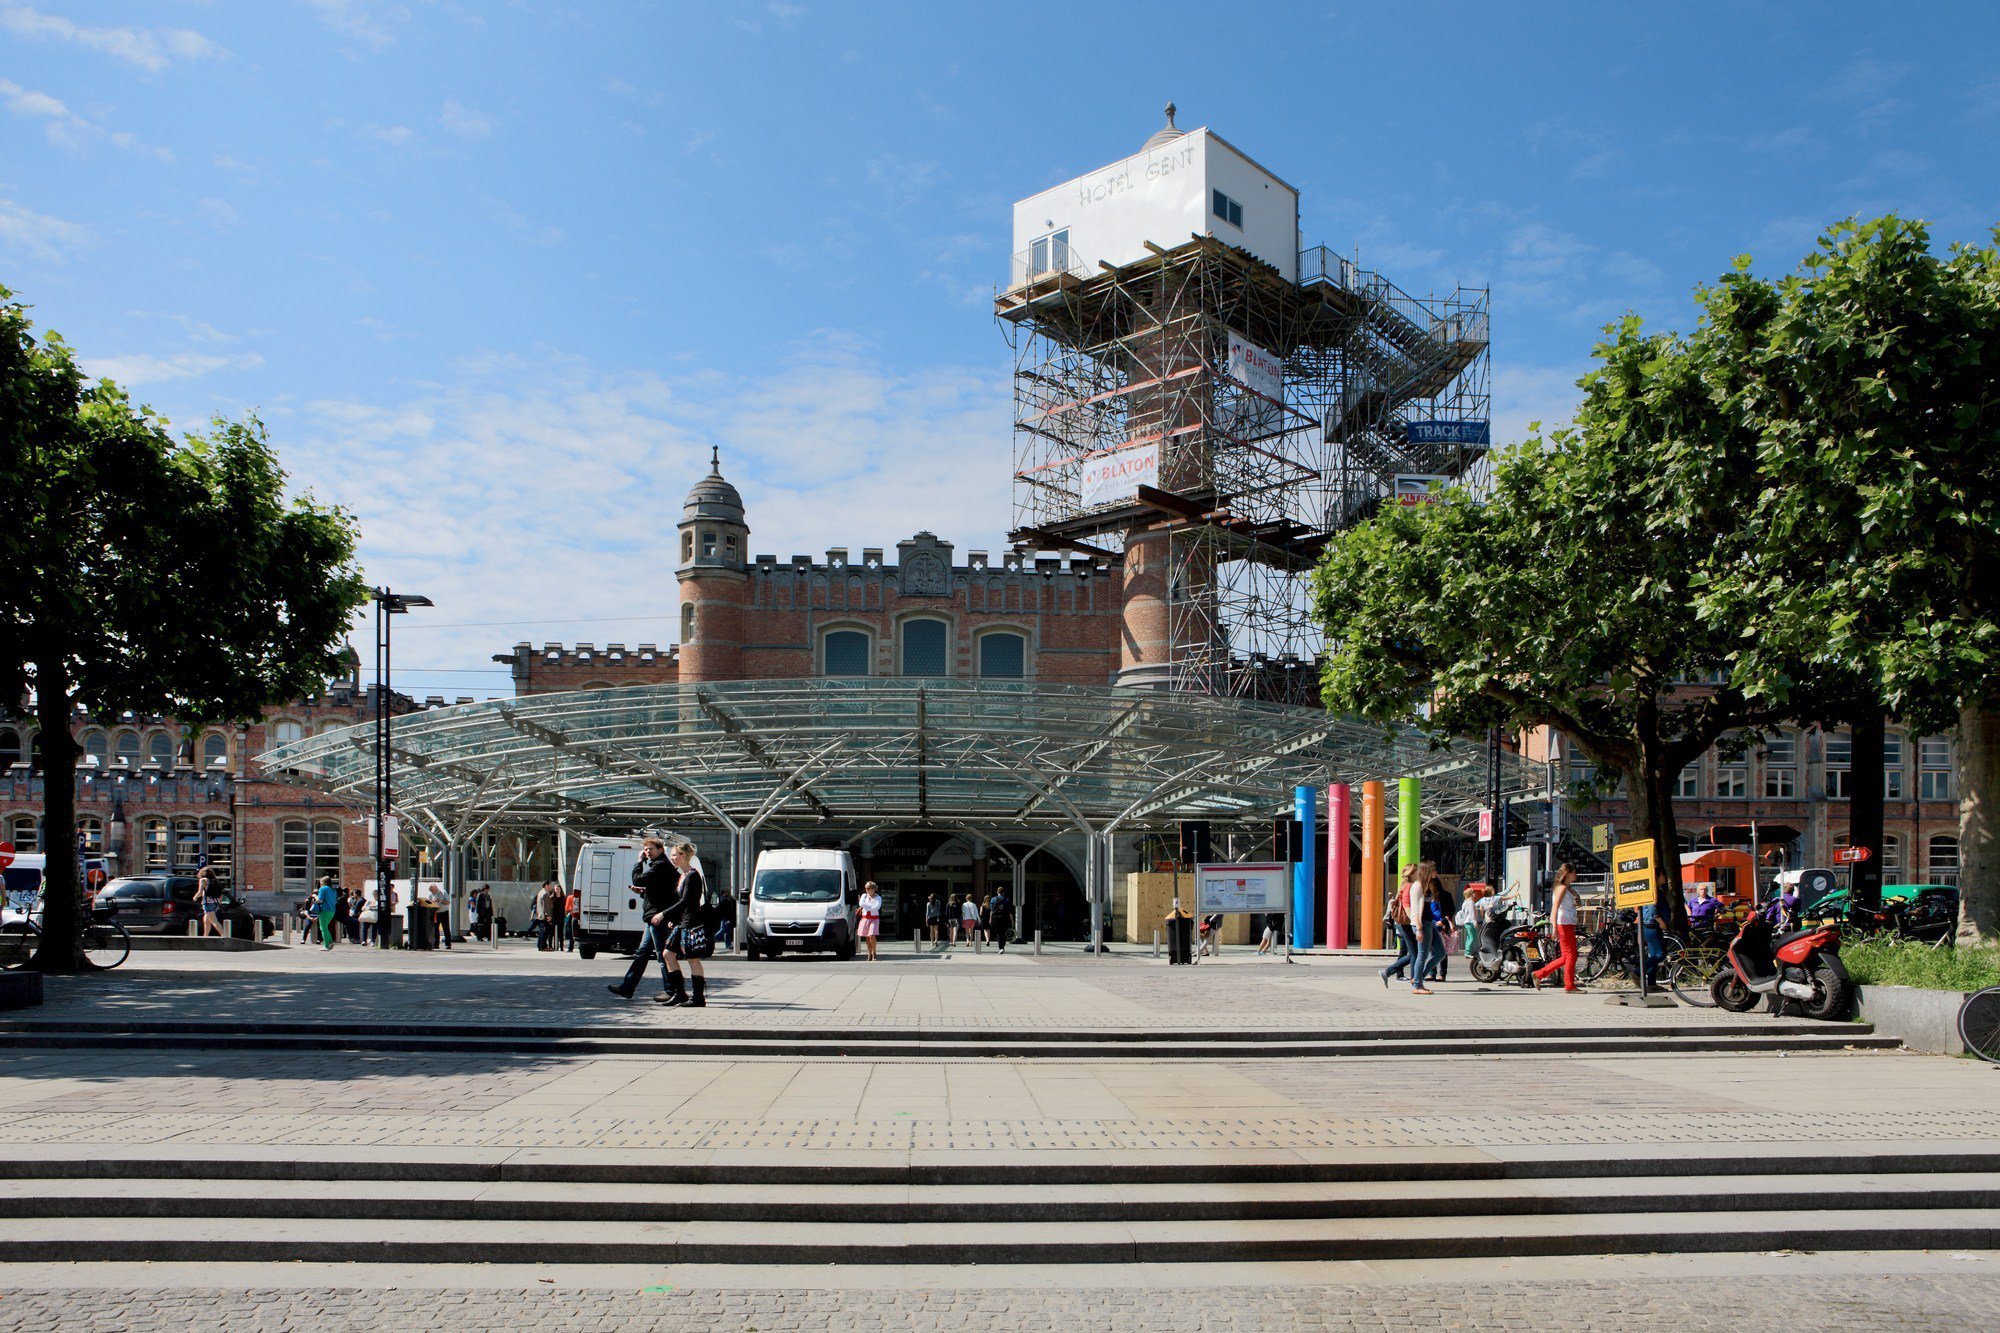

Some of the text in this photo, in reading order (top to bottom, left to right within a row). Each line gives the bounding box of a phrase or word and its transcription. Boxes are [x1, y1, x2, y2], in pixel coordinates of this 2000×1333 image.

[1079, 146, 1194, 207] HOTEL GENT
[1245, 348, 1280, 380] BLATON
[1415, 425, 1461, 438] TRACK
[1102, 455, 1155, 481] BLATON
[1481, 817, 1488, 832] A
[79, 835, 85, 848] P
[199, 855, 206, 867] P
